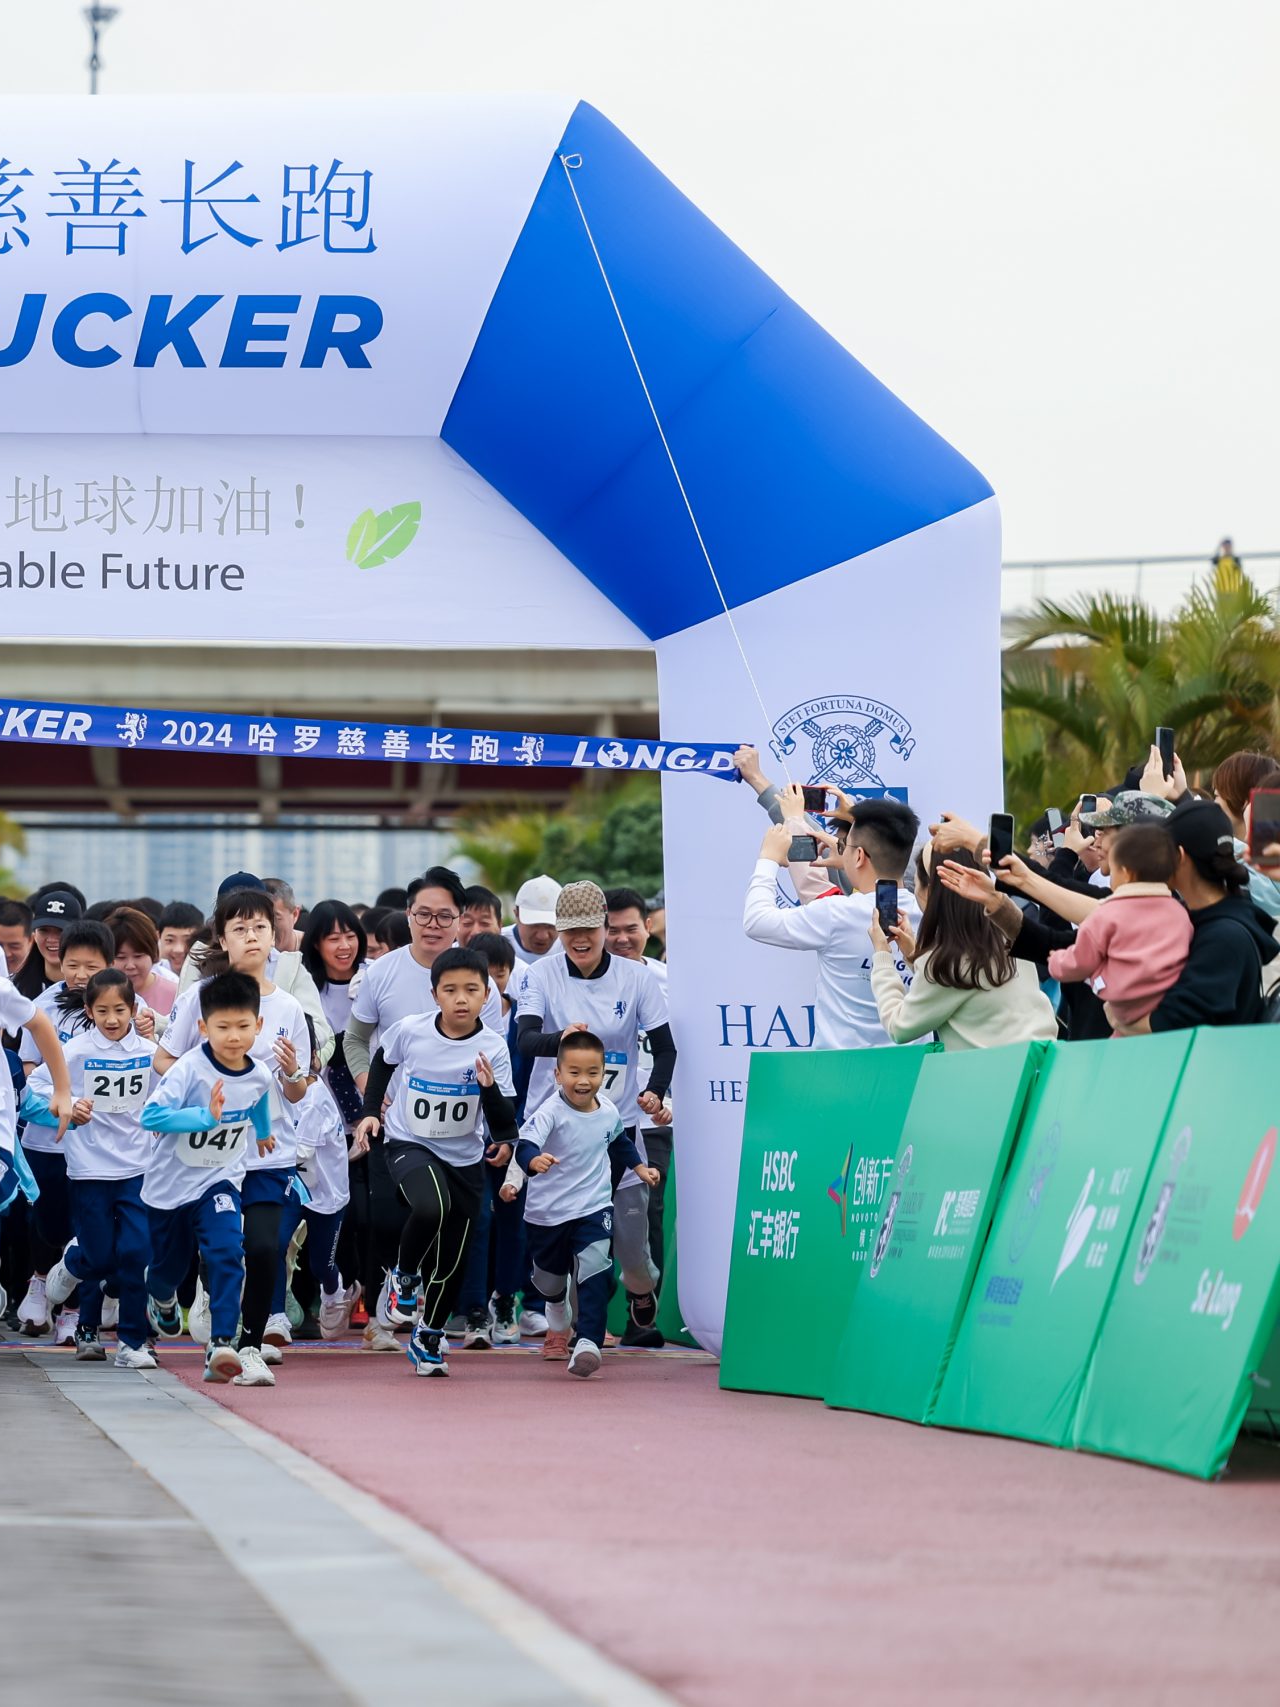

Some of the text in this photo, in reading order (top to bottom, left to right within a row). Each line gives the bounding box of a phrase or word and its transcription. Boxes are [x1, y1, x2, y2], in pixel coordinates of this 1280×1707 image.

[102, 553, 244, 591] Future
[777, 699, 908, 735] STET FORTUNA DOMUS
[162, 721, 499, 763] 2024 哈罗慈善长跑
[93, 1074, 143, 1098] 215
[413, 1098, 469, 1123] 010
[188, 1126, 245, 1151] 047
[760, 1150, 798, 1192] HSBC
[747, 1208, 800, 1260] 汇丰银行
